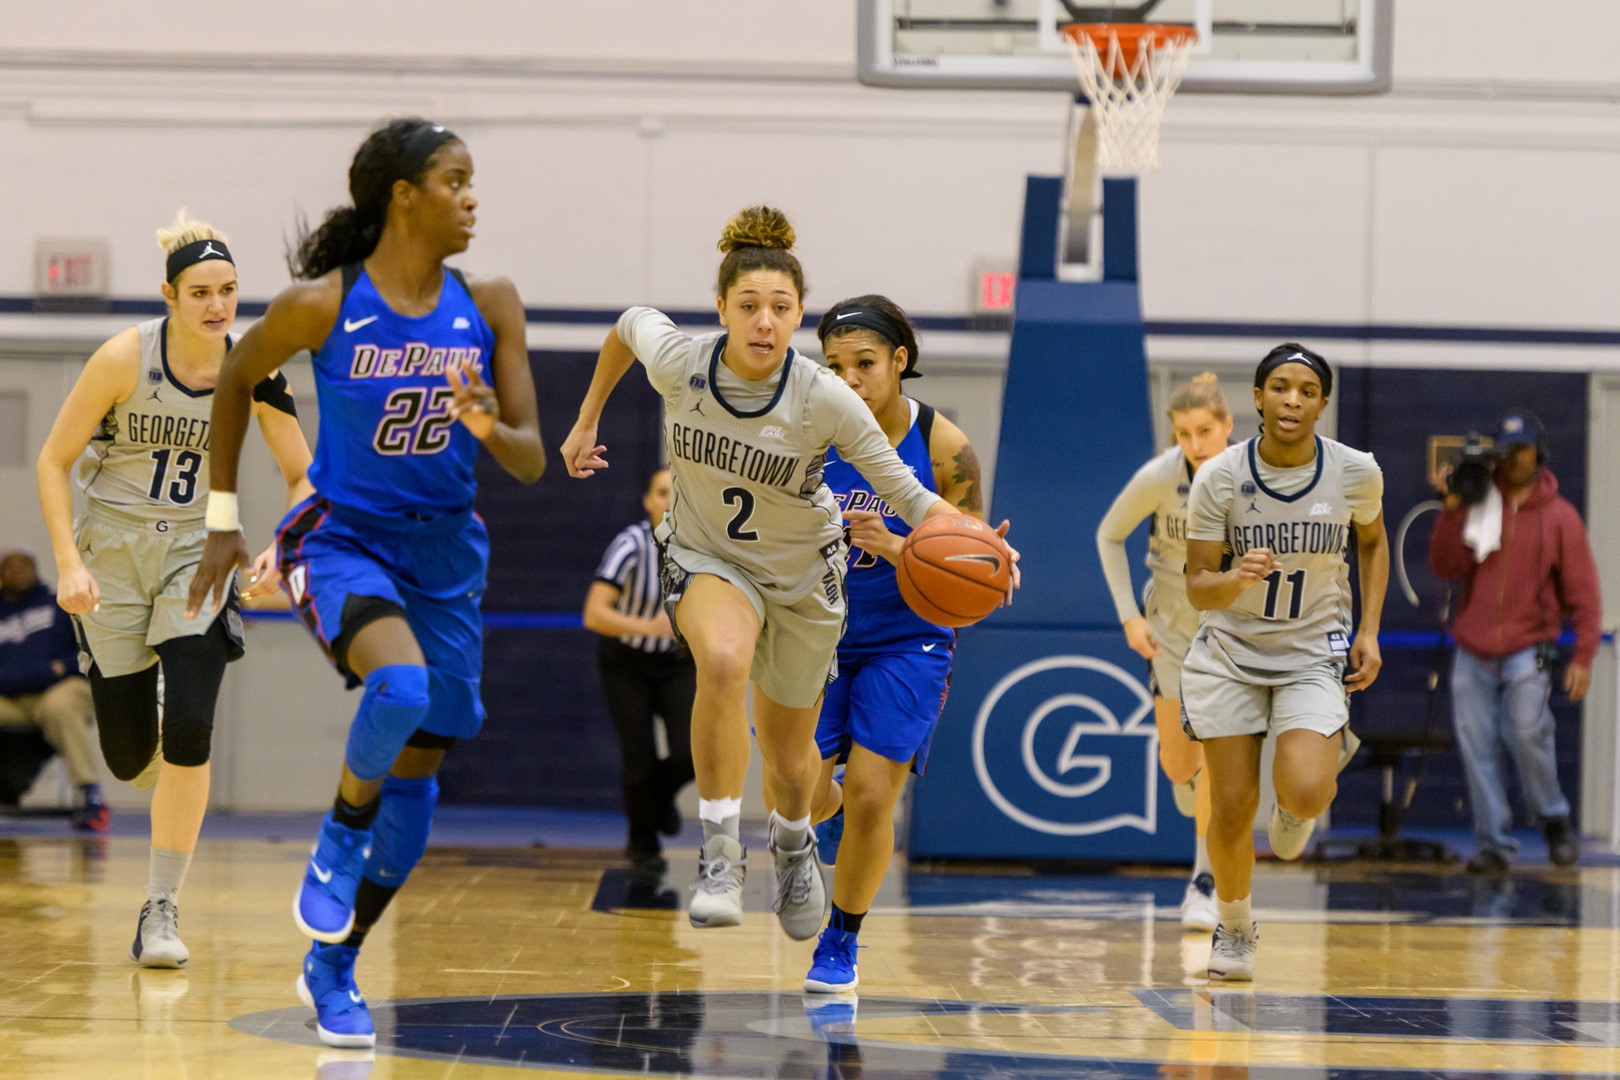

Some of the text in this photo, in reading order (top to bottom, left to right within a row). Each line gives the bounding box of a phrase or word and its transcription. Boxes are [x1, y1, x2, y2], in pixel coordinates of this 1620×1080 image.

[982, 271, 1017, 308] EX
[128, 412, 210, 450] GEORGET
[373, 386, 459, 456] 22
[149, 449, 203, 506] 13
[673, 422, 800, 488] GEORGETOWN
[156, 520, 168, 532] G
[722, 486, 760, 542] 2
[1262, 568, 1306, 620] 11
[971, 654, 1160, 835] G
